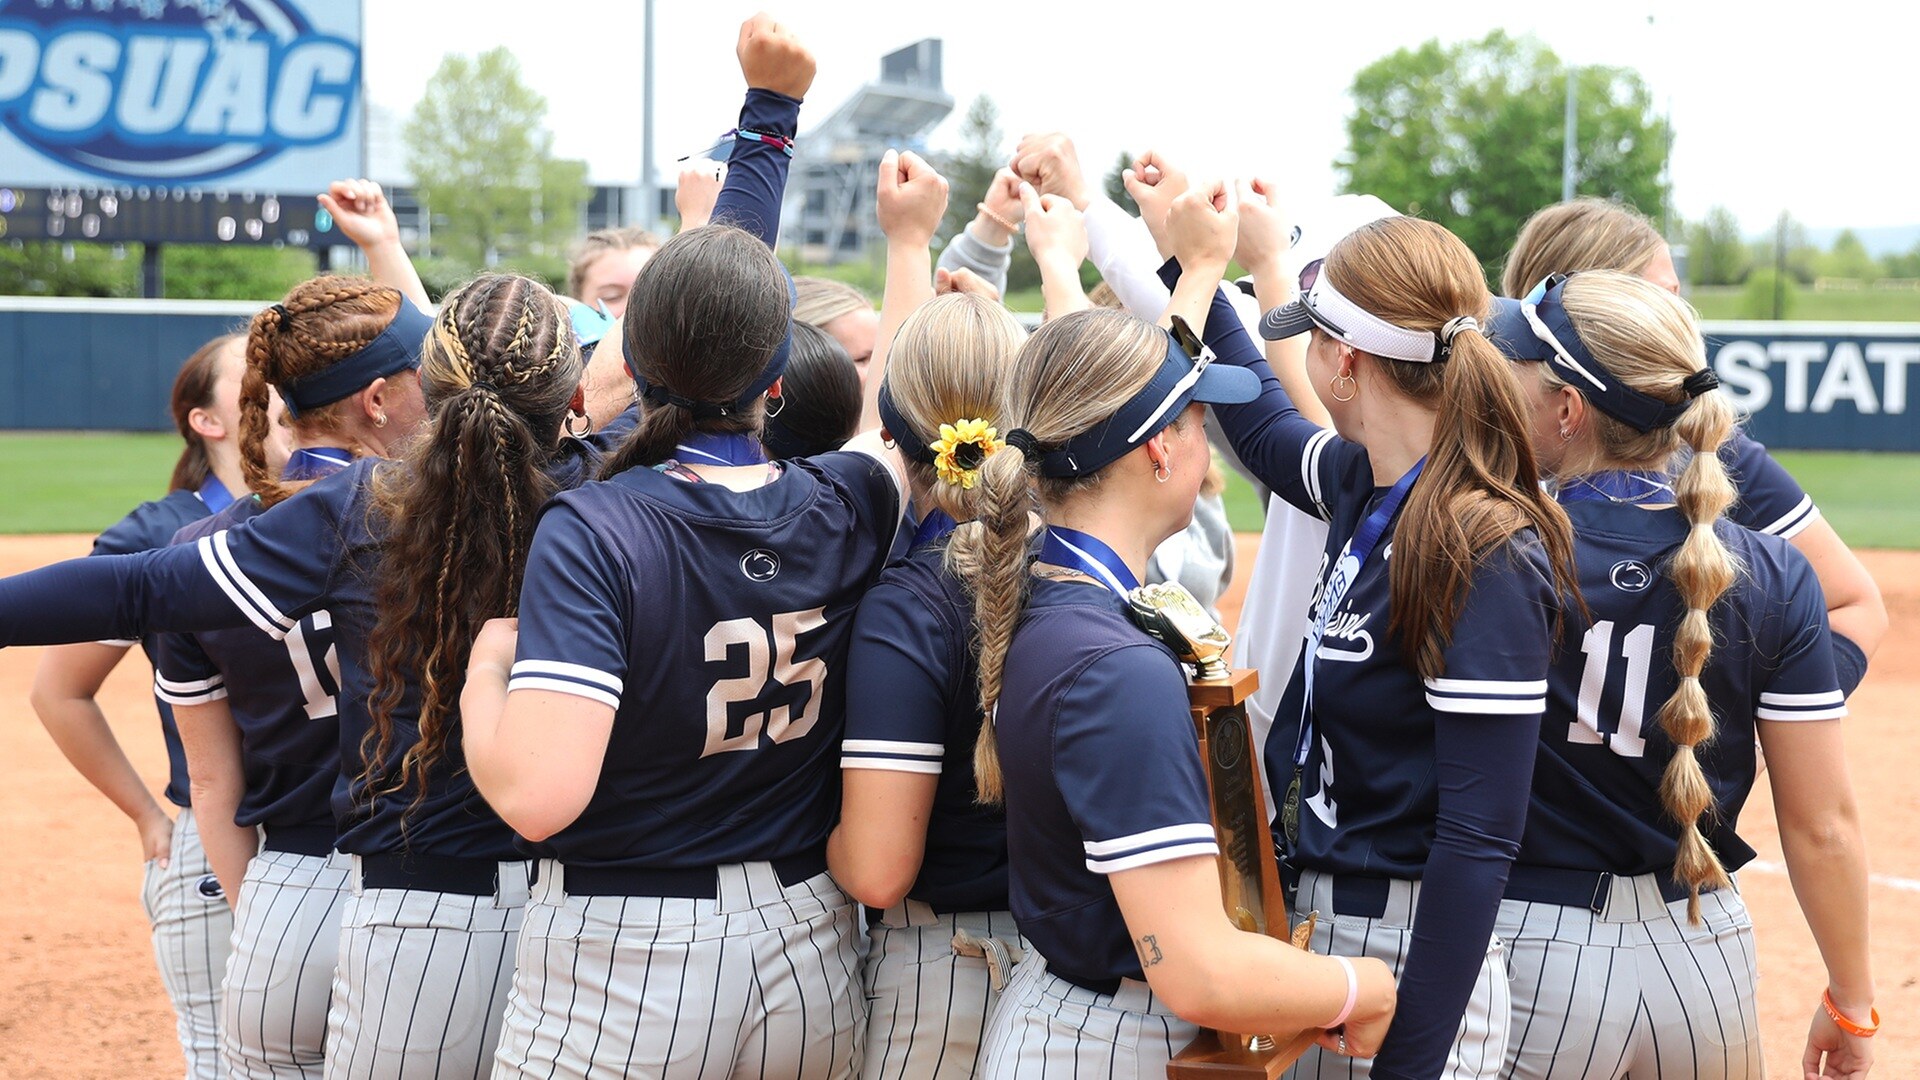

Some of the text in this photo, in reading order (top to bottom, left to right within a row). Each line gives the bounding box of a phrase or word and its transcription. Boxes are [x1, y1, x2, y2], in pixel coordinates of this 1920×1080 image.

[1714, 340, 1920, 414] STAT
[698, 605, 828, 759] 25
[1567, 619, 1656, 758] 11
